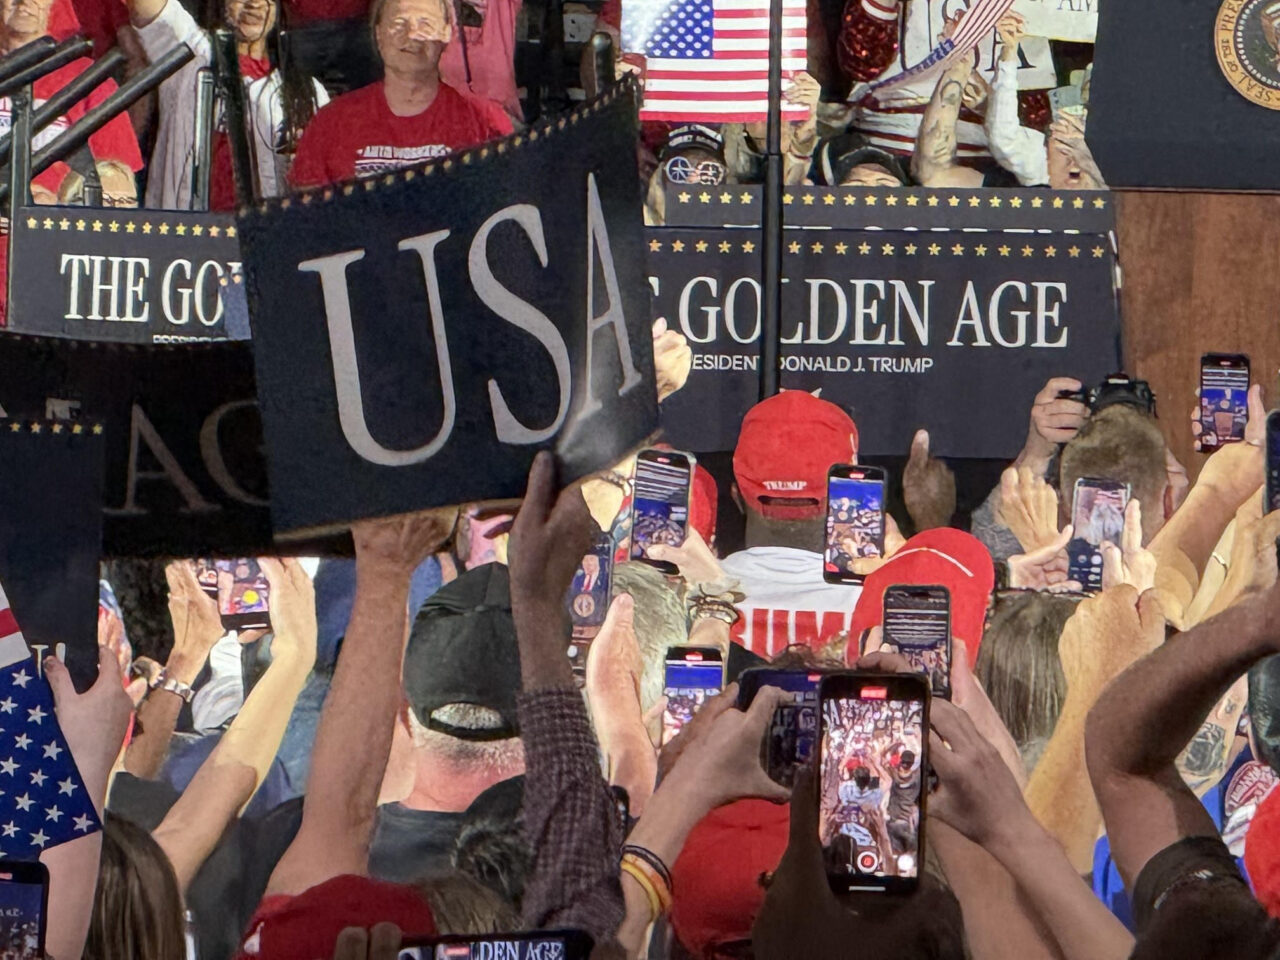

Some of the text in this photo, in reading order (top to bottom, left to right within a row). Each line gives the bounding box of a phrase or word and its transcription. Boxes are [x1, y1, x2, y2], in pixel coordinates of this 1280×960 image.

[1237, 72, 1273, 102] SEAL
[60, 254, 150, 322] THE
[298, 171, 642, 467] USA
[945, 280, 1068, 348] AGE
[853, 356, 866, 372] J.
[867, 357, 934, 374] TRUMP
[763, 480, 807, 490] TRUMP
